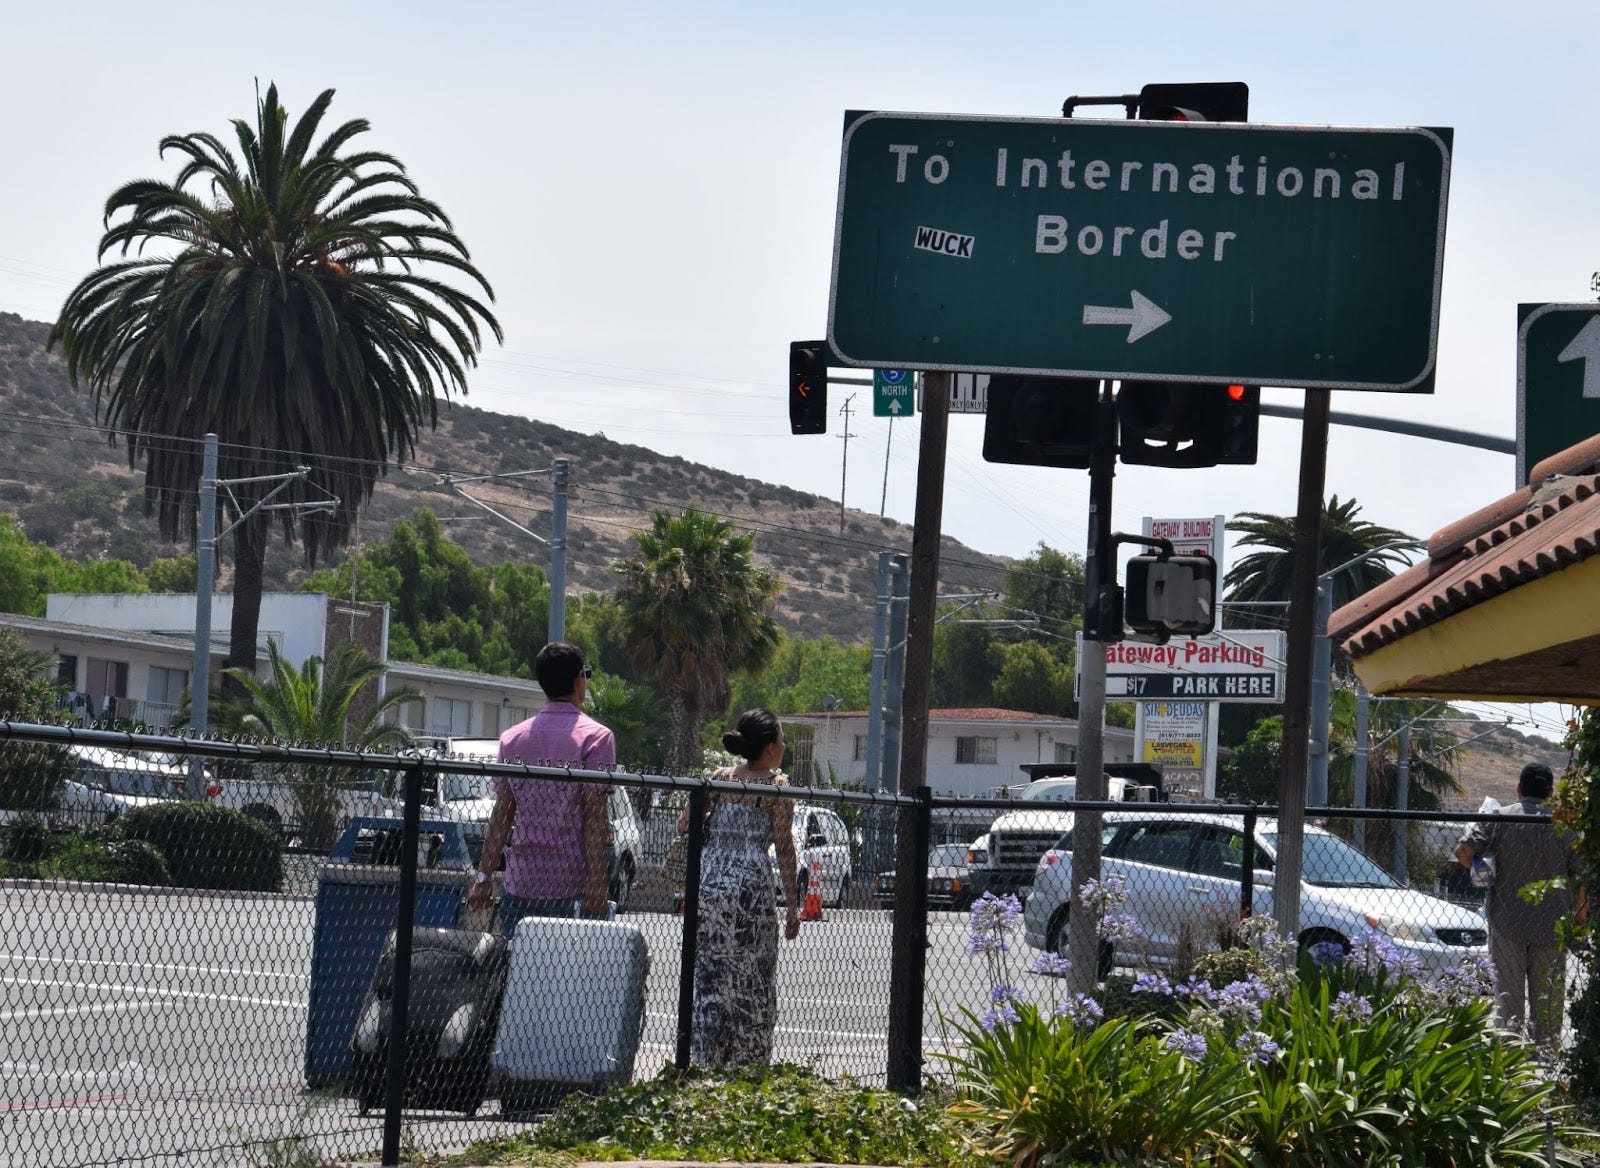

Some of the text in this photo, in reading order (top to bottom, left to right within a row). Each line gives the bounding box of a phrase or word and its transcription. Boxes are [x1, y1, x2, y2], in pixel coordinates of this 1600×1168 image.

[889, 144, 1405, 200] To International
[917, 227, 972, 257] WUCK
[1035, 214, 1238, 261] Border
[882, 385, 908, 396] NORTH
[965, 400, 981, 410] ONLY
[1152, 521, 1211, 538] GATEWAY BUILDING
[1105, 641, 1265, 668] ateway Parking
[1172, 677, 1219, 694] PARK
[1225, 676, 1272, 694] HERE
[1166, 703, 1204, 717] DEUDAS
